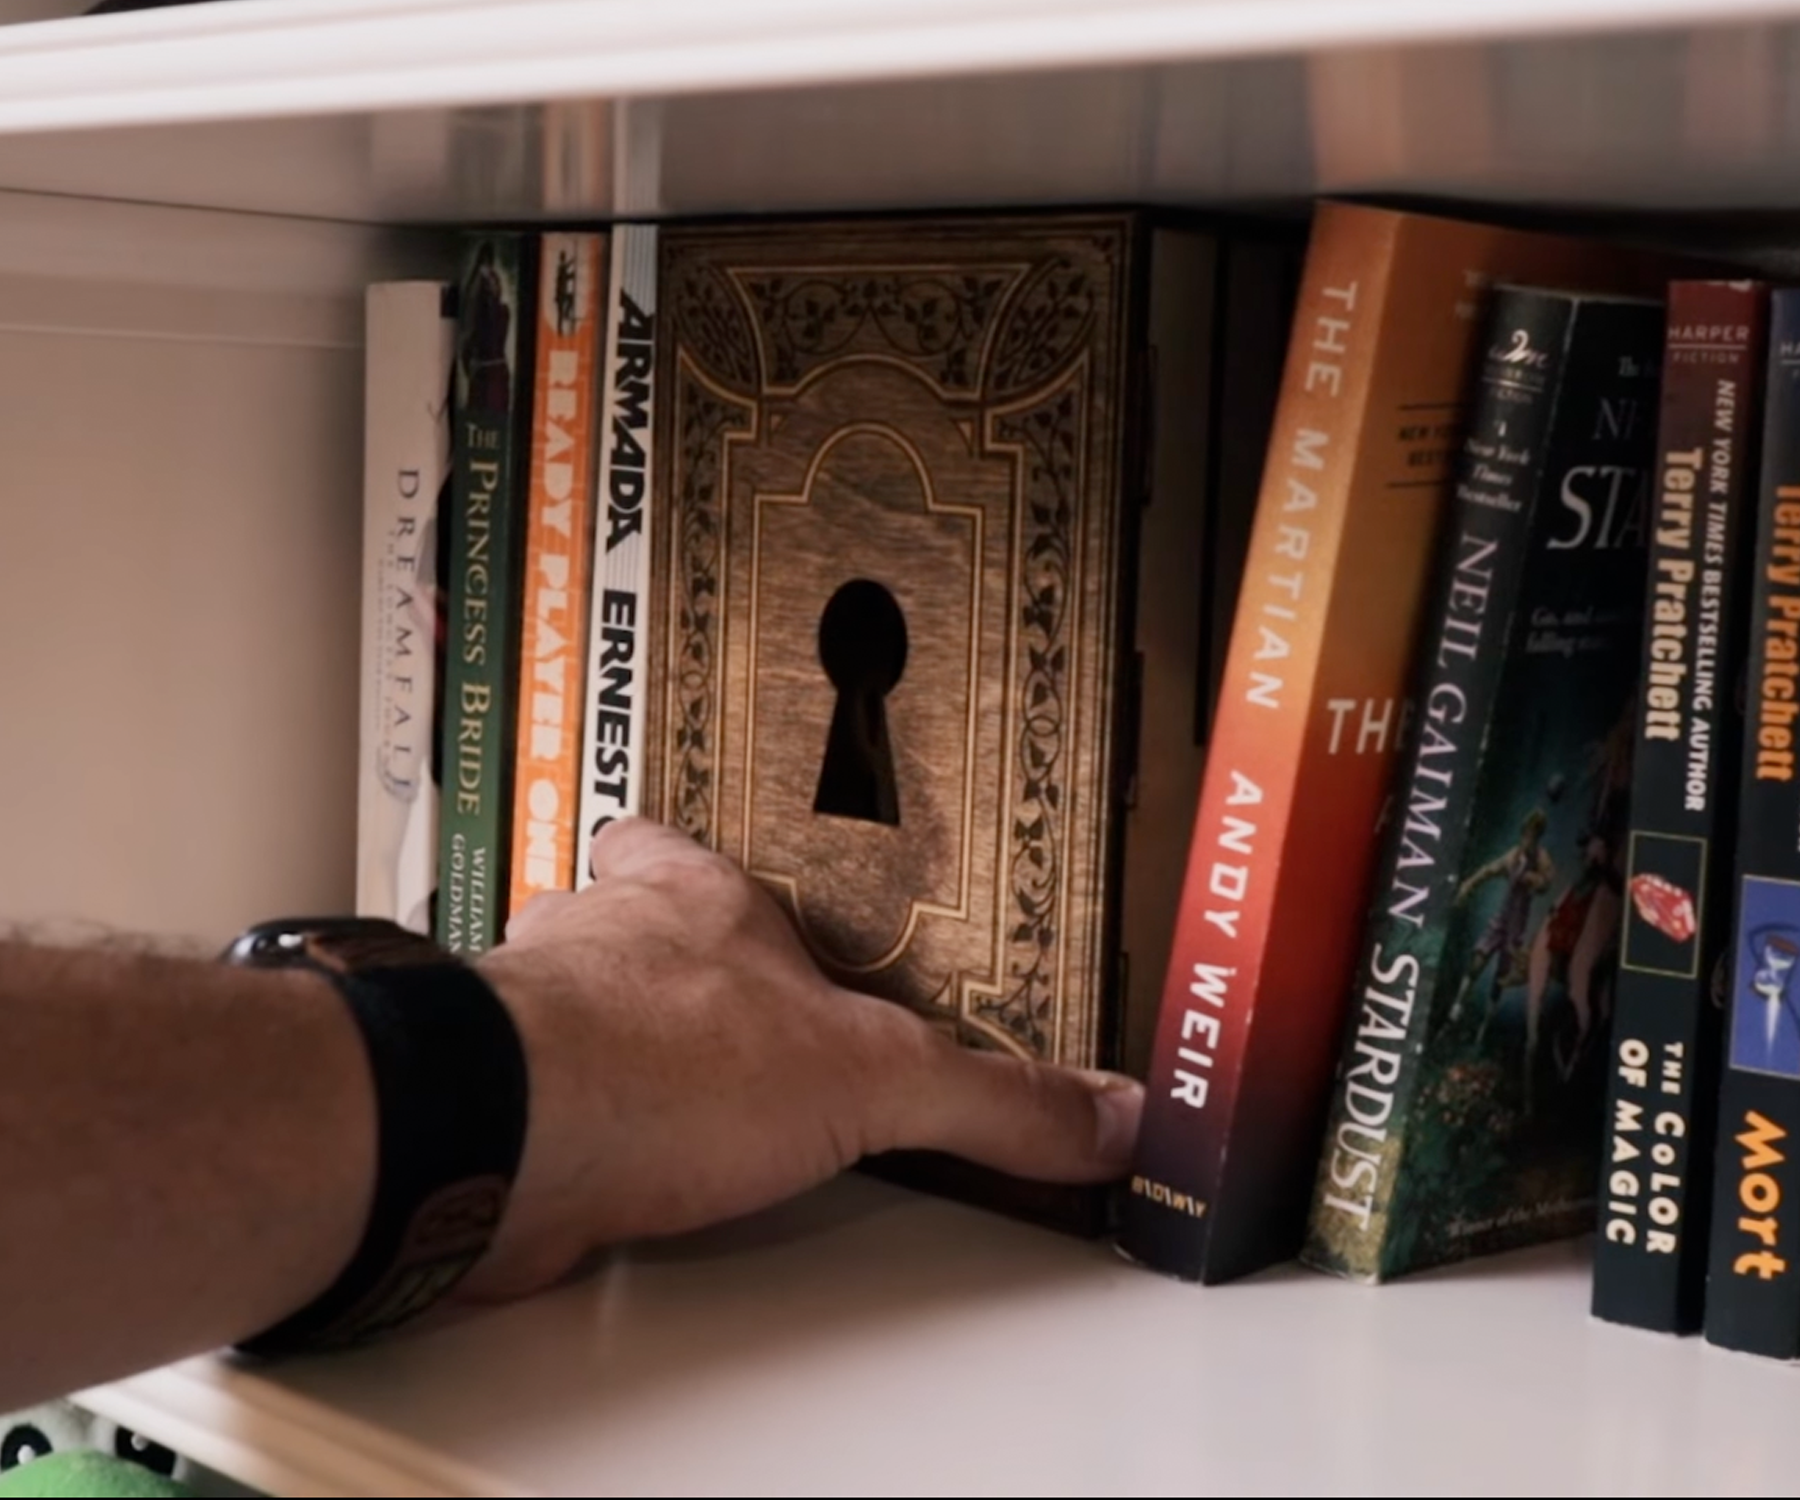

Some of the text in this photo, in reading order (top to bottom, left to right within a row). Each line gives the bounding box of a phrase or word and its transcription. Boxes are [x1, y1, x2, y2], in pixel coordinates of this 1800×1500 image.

[606, 289, 655, 554] ARMADA
[1668, 325, 1750, 341] HARPER
[1672, 351, 1740, 364] FICTION
[457, 422, 498, 816] THE PRINCESS BRIDE
[525, 350, 578, 890] READY PLAYER ONE
[594, 588, 637, 808] ERNEST
[1170, 281, 1358, 1109] THE MARTIAN ANDY WEIR
[1645, 448, 1703, 742] Terry Pratchett
[1684, 379, 1736, 812] NEW YORK TIMES BESTSELLING AUTHOR
[1756, 596, 1800, 782] Pratchett
[448, 834, 467, 954] GOLDMAN
[469, 847, 486, 953] WILLIAM
[1323, 532, 1498, 1232] NEIL GAIMAN STARDUST
[1606, 1038, 1650, 1245] OF MAGIC
[1661, 1042, 1684, 1095] THE
[1733, 1110, 1788, 1280] Mort
